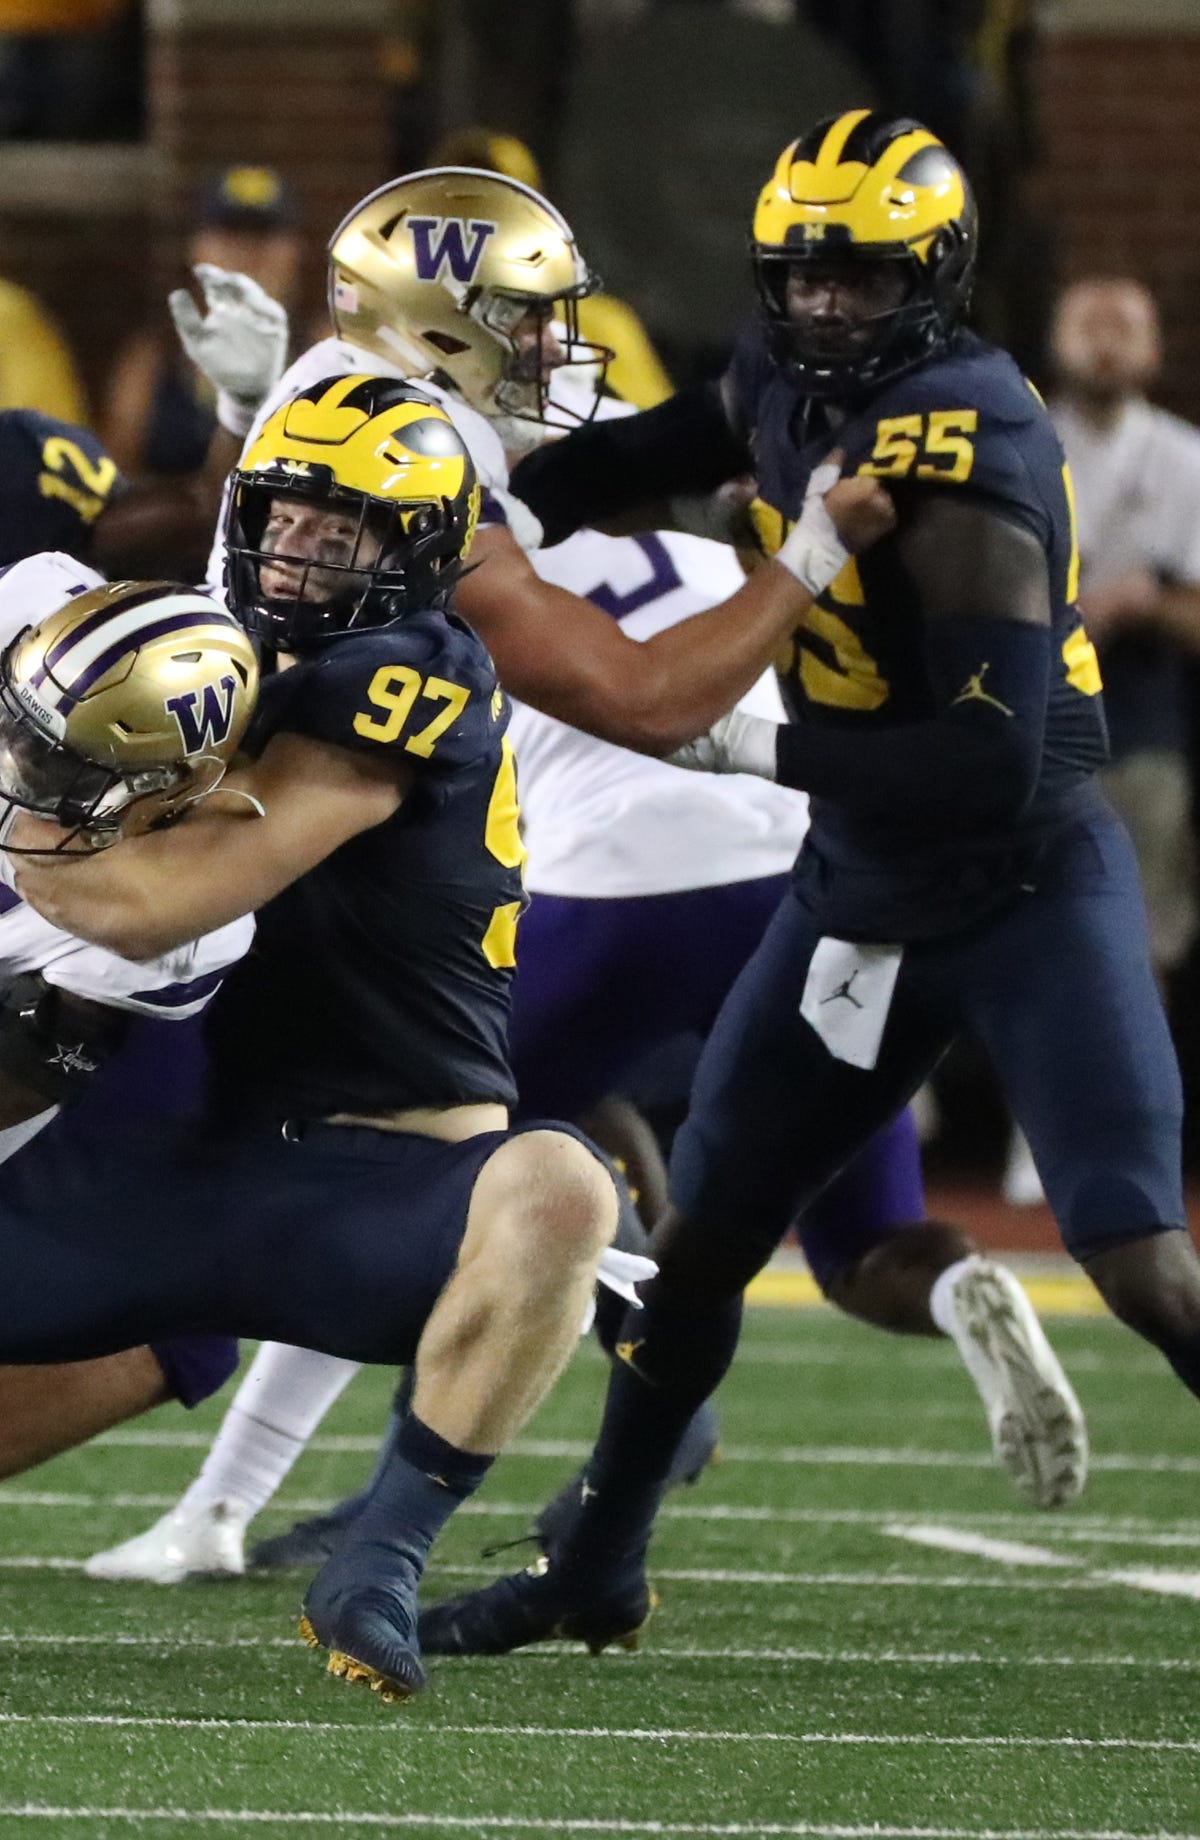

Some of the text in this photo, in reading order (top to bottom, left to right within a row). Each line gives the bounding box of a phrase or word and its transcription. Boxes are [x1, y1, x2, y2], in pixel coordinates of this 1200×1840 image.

[406, 217, 497, 284] W
[38, 437, 117, 521] 12
[857, 410, 978, 483] 55
[20, 687, 53, 724] DAWGS
[165, 675, 237, 757] W
[353, 665, 472, 759] 97
